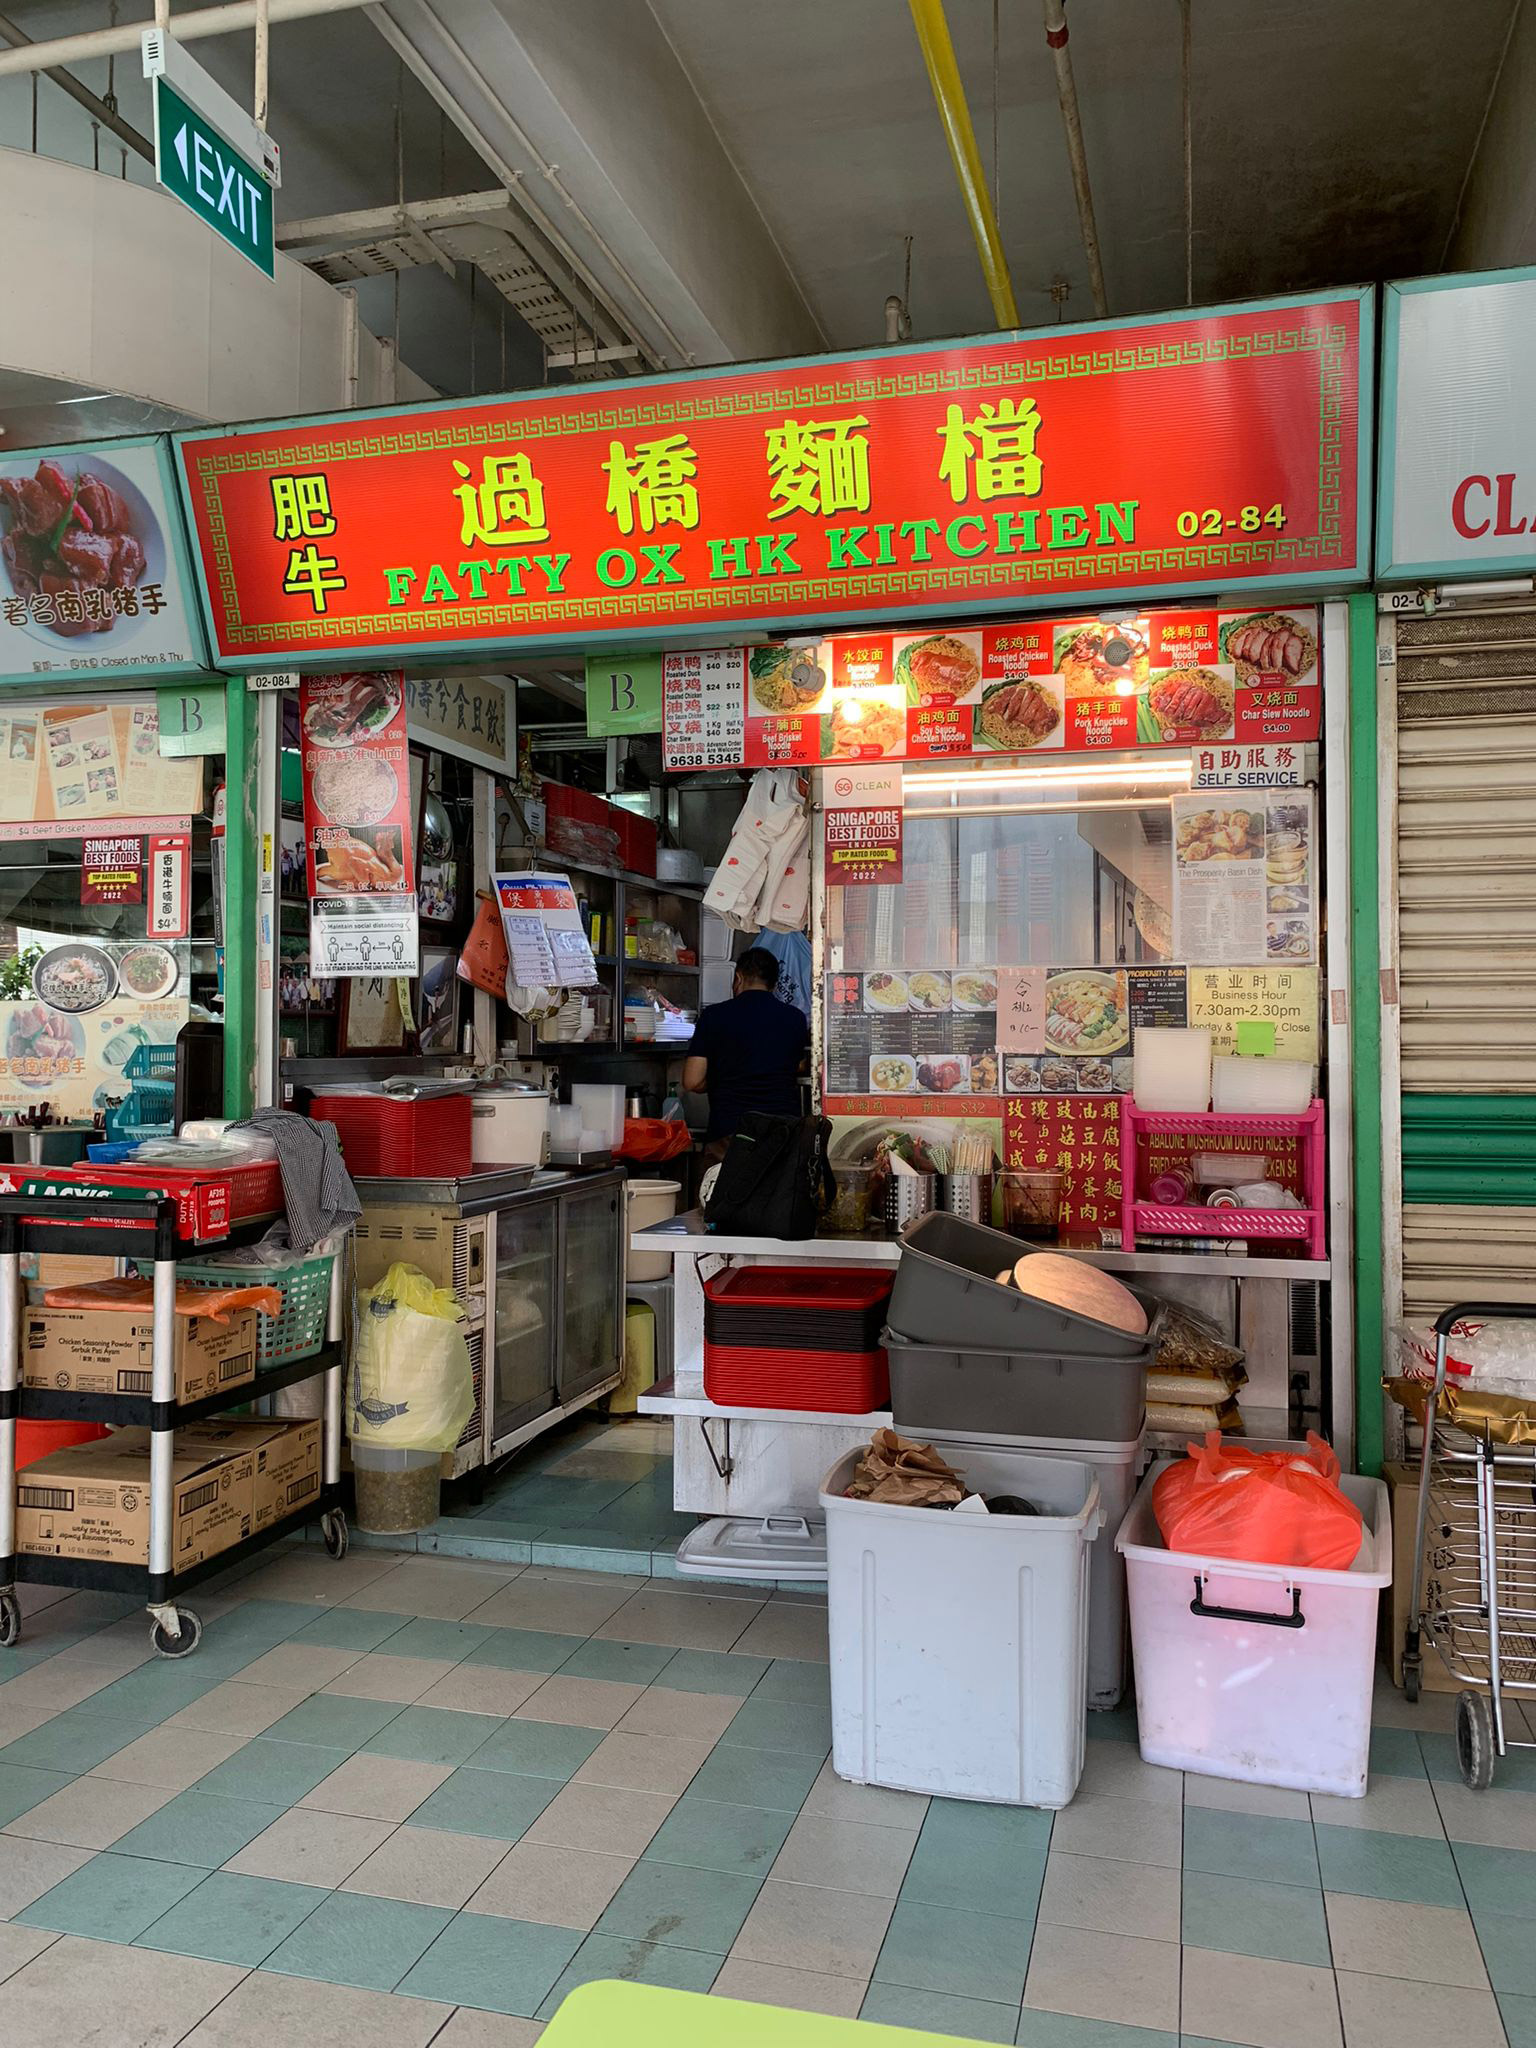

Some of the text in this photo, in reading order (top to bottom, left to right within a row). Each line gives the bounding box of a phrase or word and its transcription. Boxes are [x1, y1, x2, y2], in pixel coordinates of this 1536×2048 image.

[193, 130, 262, 246] EXIT
[452, 397, 1043, 547] 過橋麵檔
[1452, 473, 1536, 539] CL
[1176, 503, 1288, 539] 02-84
[269, 473, 347, 613] 肥牛
[383, 500, 1139, 606] FATTY OX HK KITCHEN
[1391, 595, 1442, 609] 02-0
[1162, 624, 1209, 640] 烧鸭面
[996, 636, 1040, 651] 烧鸡面
[1160, 641, 1213, 653] Roasted Duck
[141, 654, 157, 664] Mon
[168, 652, 184, 661] Thu
[843, 648, 884, 664] 水饺面
[988, 651, 1049, 664] Roasted Chicken
[1172, 650, 1199, 660] Noodle
[706, 661, 741, 670] $40 $20
[1003, 661, 1029, 670] Noodle
[1172, 661, 1199, 669] $5.00
[255, 675, 290, 688] 02-084
[1004, 672, 1029, 680] $4.00
[666, 678, 701, 693] 烧鸡
[726, 682, 741, 690] $12
[609, 673, 636, 712] B
[1251, 690, 1299, 707] 叉烧面
[667, 699, 701, 714] 油鸡
[1076, 701, 1123, 716] 猪手面
[181, 697, 204, 733] B
[918, 710, 960, 725] 油鸡面
[1241, 708, 1310, 720] Char Siew Noodle
[667, 720, 702, 736] 叉烧
[712, 721, 721, 729] Kg
[1074, 716, 1128, 728] Pork Knuckles
[706, 729, 720, 737] $40
[920, 725, 956, 736] Soy Sauce
[1086, 726, 1112, 735] Noodle
[1263, 724, 1290, 733] $4.00
[763, 733, 802, 743] Beef Brisket
[912, 732, 966, 744] Chicken Noodle
[1086, 736, 1112, 745] $4.00
[768, 741, 791, 750] Noodle
[670, 753, 740, 766] 9638 5345
[1199, 747, 1297, 771] 自助服務
[1198, 772, 1299, 786] SELF SERVICE
[855, 781, 892, 791] CLEAN
[179, 820, 191, 829] $4
[828, 811, 898, 826] SINGAPORE
[316, 829, 350, 843] 油鸡
[829, 826, 897, 840] BEST FOODS
[85, 839, 140, 852] SINGAPORE
[86, 852, 138, 864] BEST FOODS
[850, 850, 868, 858] RATED
[853, 872, 876, 880] 2022
[1178, 867, 1263, 878] The Prosperity Basin Dish
[103, 891, 121, 899] 2022
[373, 922, 404, 930] distancing
[1204, 974, 1292, 989] 营业时间
[1211, 990, 1287, 1000] Business Hour
[1194, 1004, 1301, 1018] 7.30am-2.30pm
[1190, 1022, 1233, 1033] onday &
[1281, 1022, 1310, 1032] Close
[1150, 1133, 1185, 1149] ABALONE
[1266, 1136, 1284, 1150] RICE
[58, 1337, 134, 1348] Chicken Seasoning Powder
[72, 1526, 87, 1534] Ayam
[58, 1533, 135, 1546] Chicken Seasoning Powder
